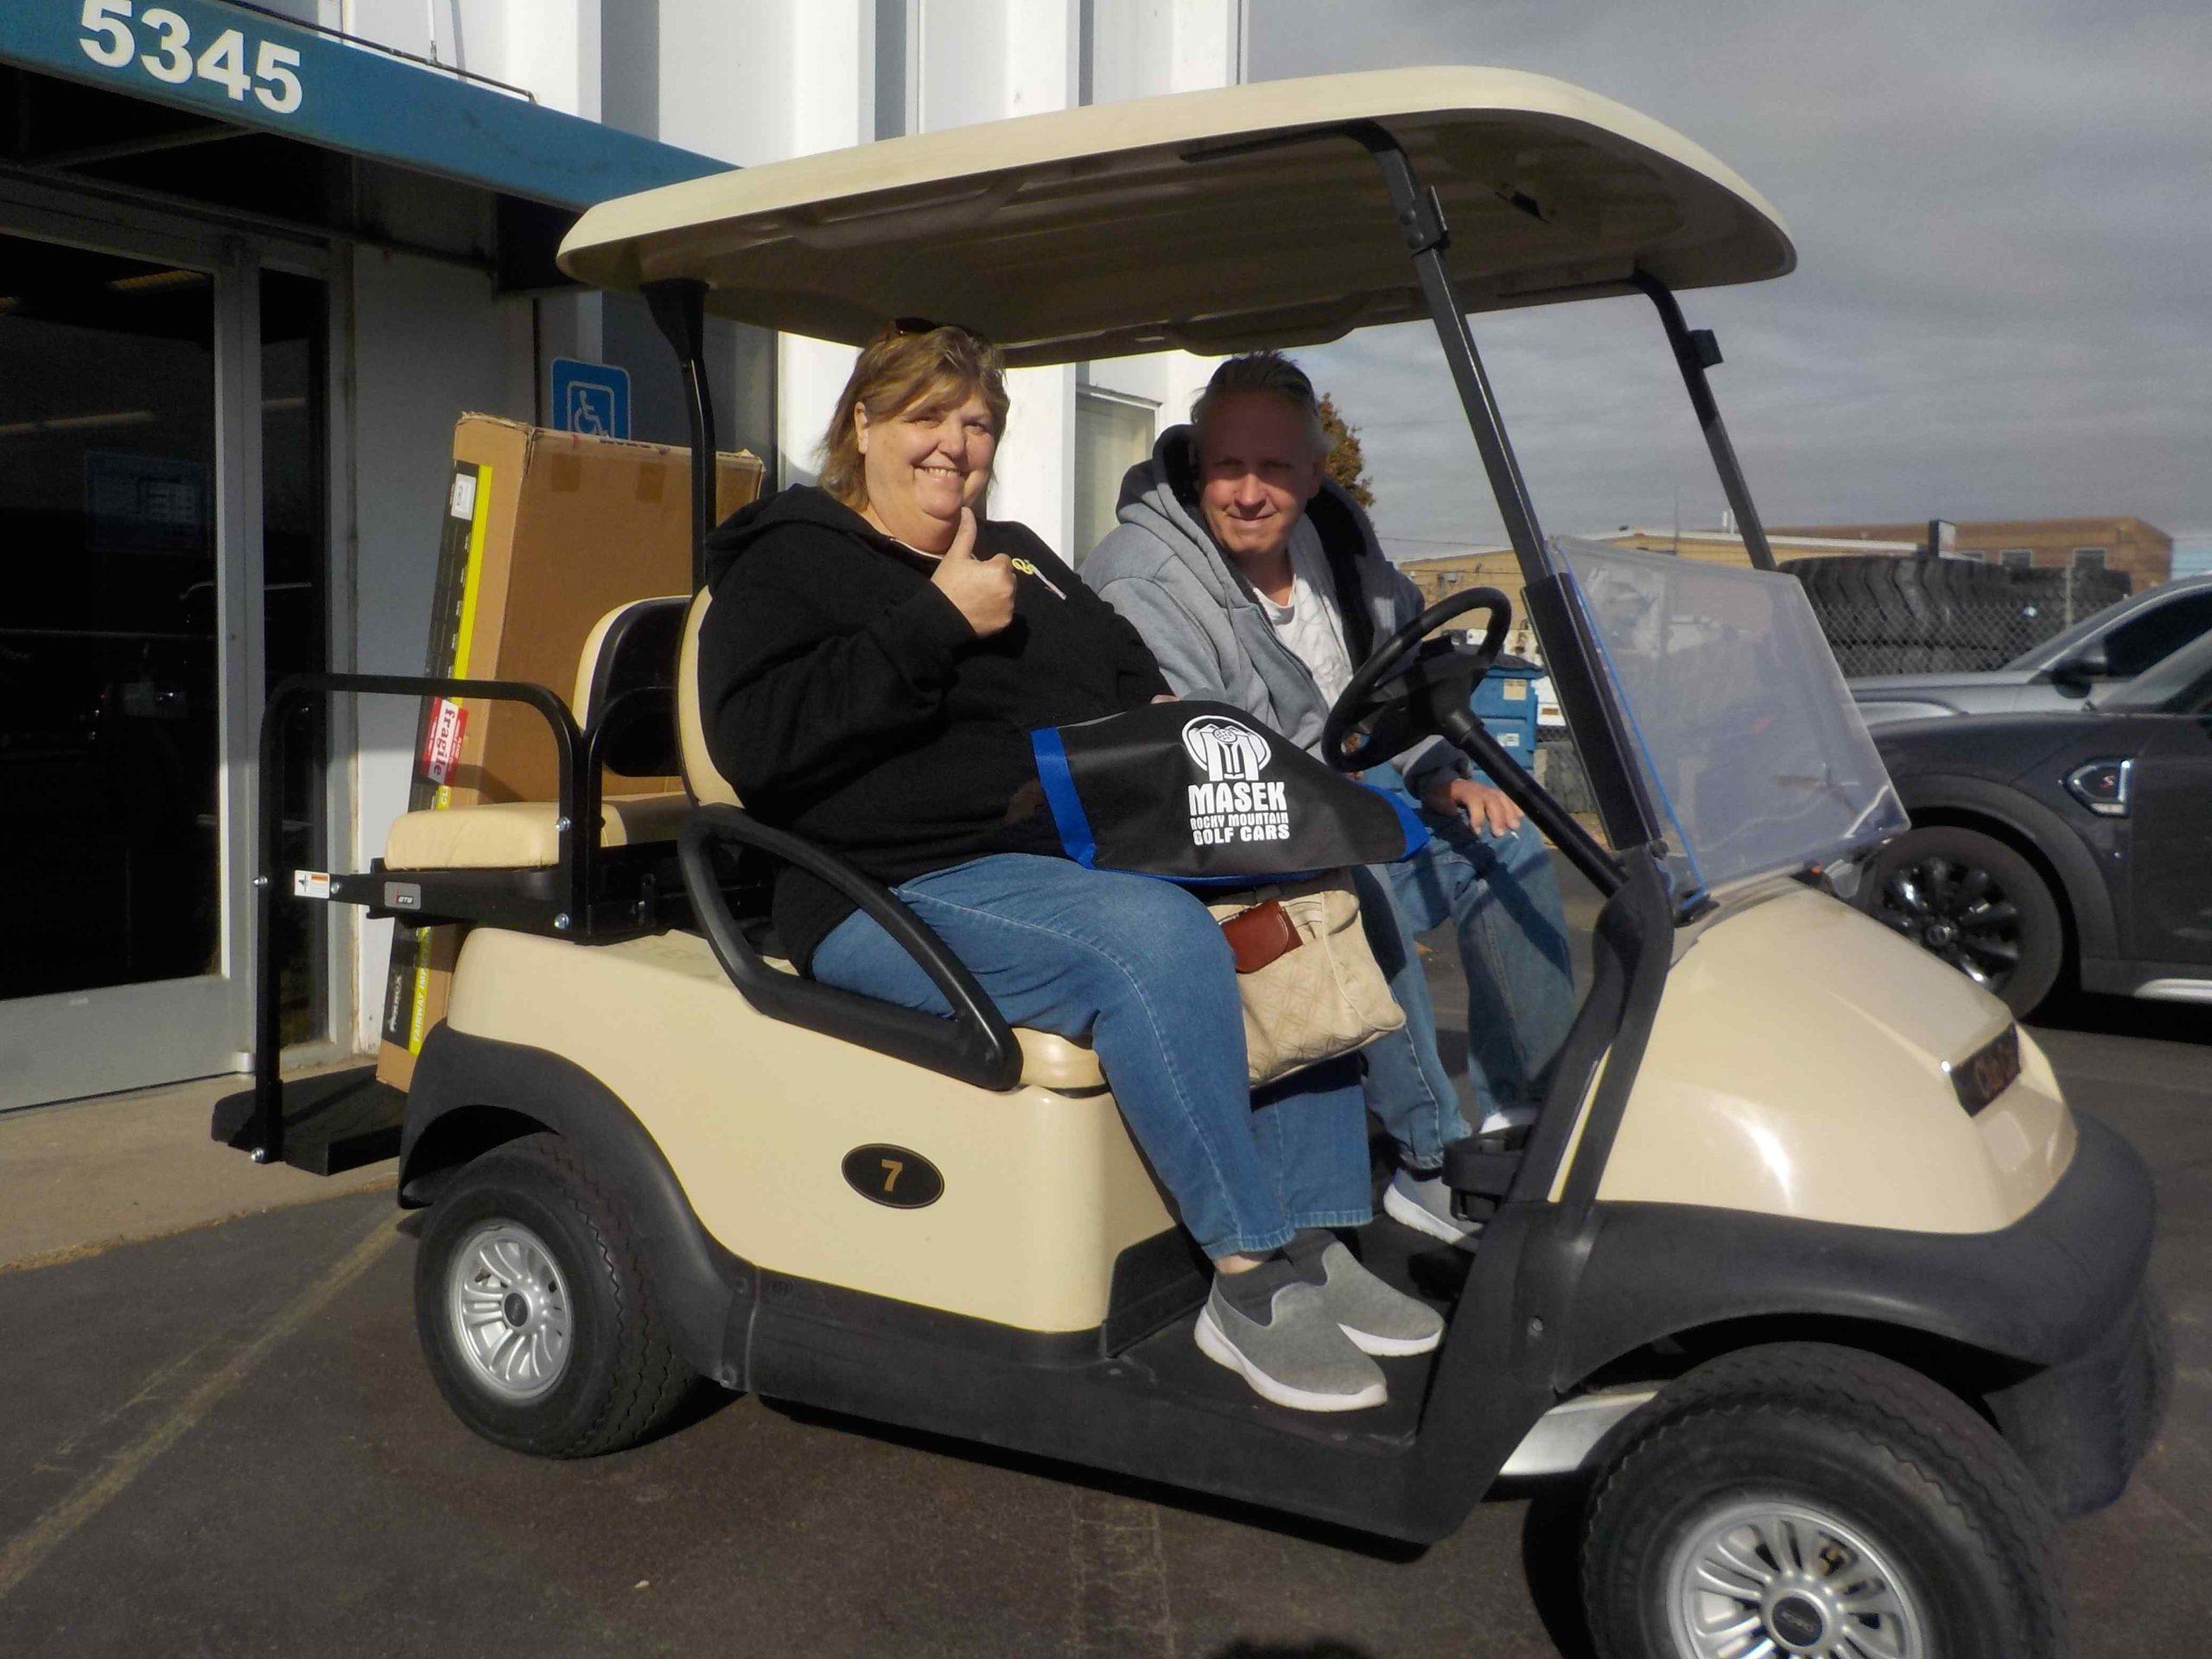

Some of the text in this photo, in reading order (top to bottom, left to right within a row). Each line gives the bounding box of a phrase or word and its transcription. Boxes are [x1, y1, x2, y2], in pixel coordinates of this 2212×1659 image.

[79, 0, 302, 114] 5345
[434, 709, 455, 776] fragile
[1188, 781, 1287, 817] MASEK
[1190, 812, 1289, 830] ROCKY MOUNTAIN
[1192, 823, 1290, 846] GOLF CARS
[414, 993, 425, 1042] FAIRWAY
[881, 1159, 903, 1192] 7
